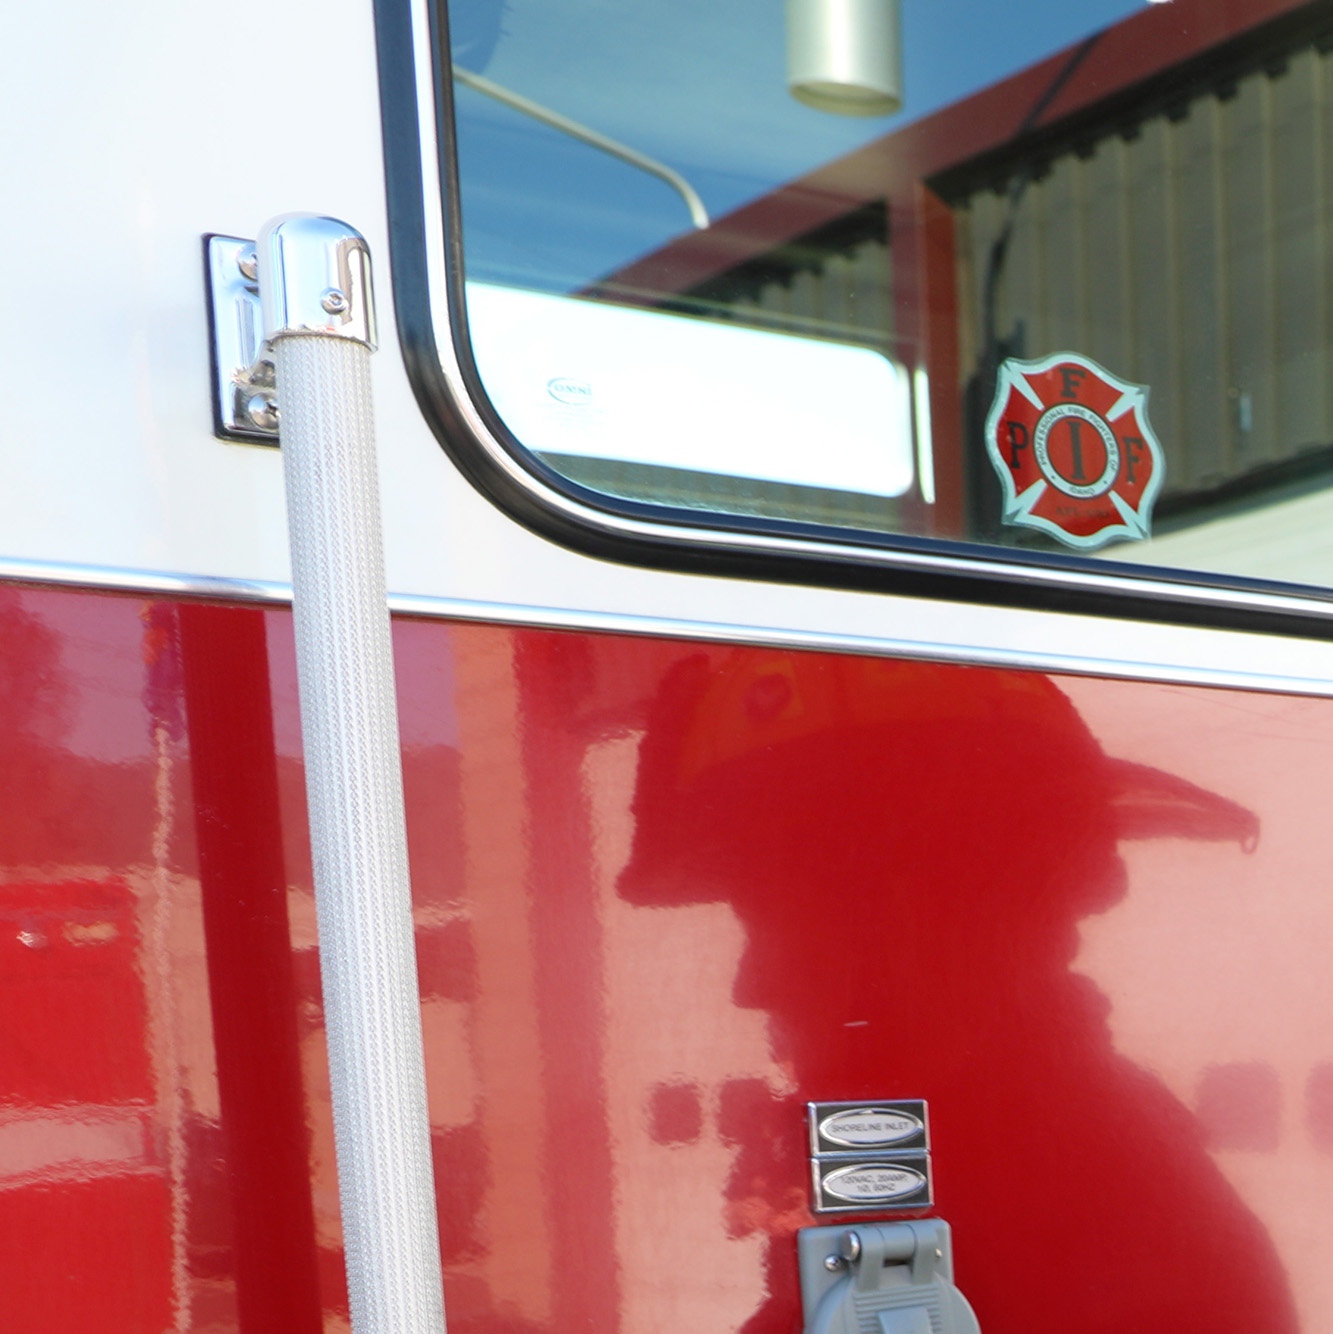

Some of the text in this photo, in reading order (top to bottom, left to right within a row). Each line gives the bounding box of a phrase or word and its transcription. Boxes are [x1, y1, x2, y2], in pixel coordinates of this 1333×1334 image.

[1059, 368, 1087, 399] F
[1006, 421, 1030, 469] P
[1122, 437, 1144, 483] F
[831, 1121, 909, 1133] SHORELINE INLET
